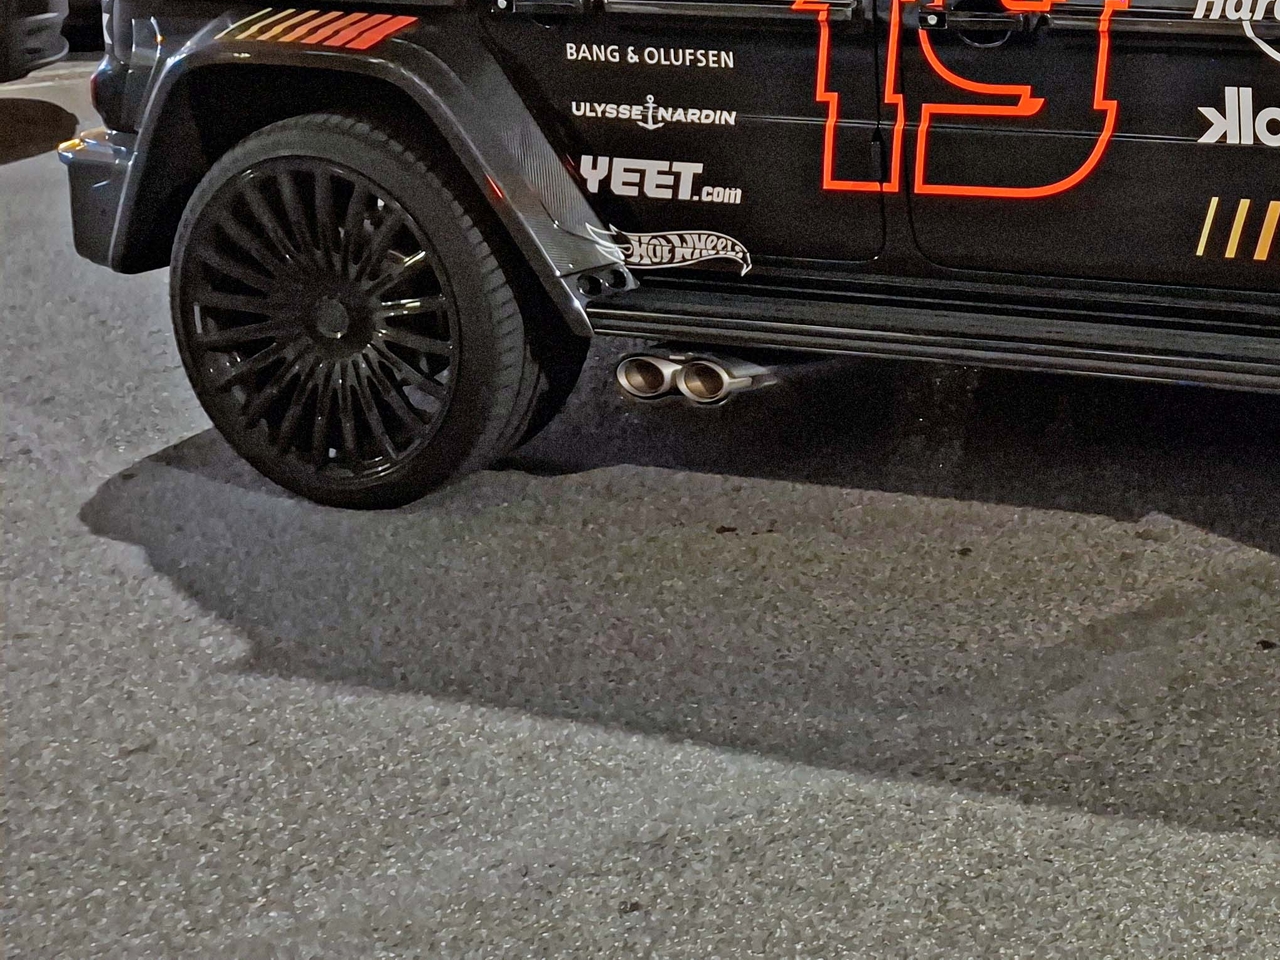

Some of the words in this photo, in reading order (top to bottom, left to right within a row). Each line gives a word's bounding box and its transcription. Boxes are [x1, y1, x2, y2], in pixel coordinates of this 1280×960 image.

[565, 43, 620, 63] BANG
[627, 45, 640, 63] &
[644, 46, 735, 69] OLUFSEN
[571, 100, 643, 120] ULYSSE
[657, 106, 737, 126] NARDIN
